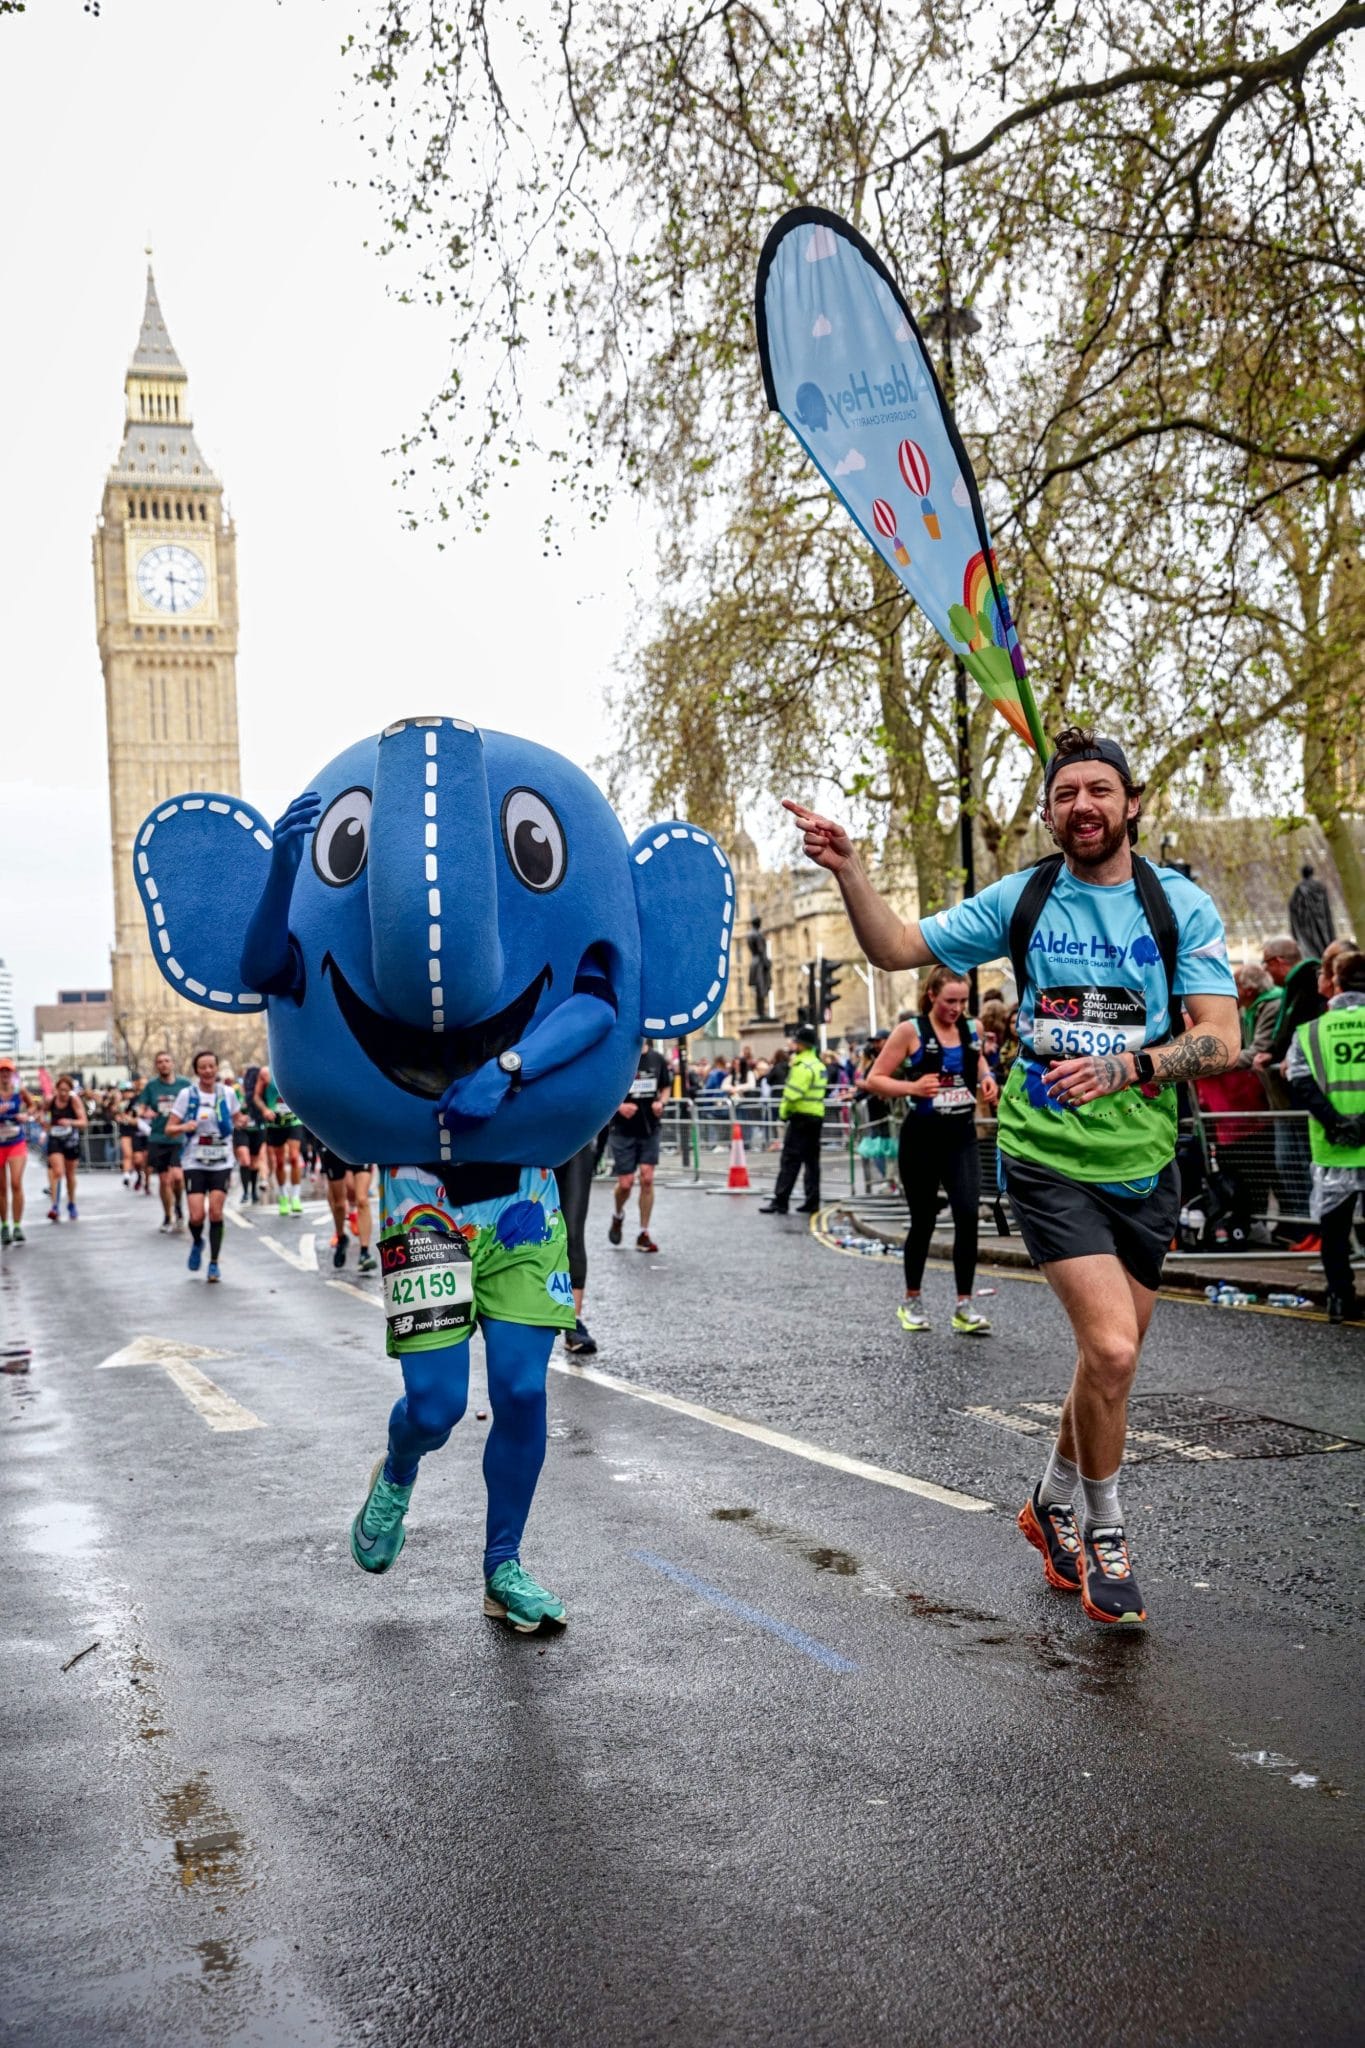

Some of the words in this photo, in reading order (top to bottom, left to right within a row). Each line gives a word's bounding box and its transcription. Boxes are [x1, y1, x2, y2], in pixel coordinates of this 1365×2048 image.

[1029, 929, 1088, 956] Alder
[1091, 935, 1128, 968] Hey
[1083, 992, 1107, 1001] TATA
[1082, 1000, 1139, 1011] CONSULTANCY
[1082, 1009, 1118, 1019] SERVICES
[1326, 1020, 1365, 1032] STEWA
[1050, 1027, 1127, 1056] 35396
[408, 1237, 432, 1246] TATA
[409, 1243, 462, 1254] CONSULTANCY
[410, 1251, 445, 1263] SERVICES
[391, 1271, 457, 1305] 42159
[415, 1321, 433, 1331] new
[434, 1315, 465, 1327] balance
